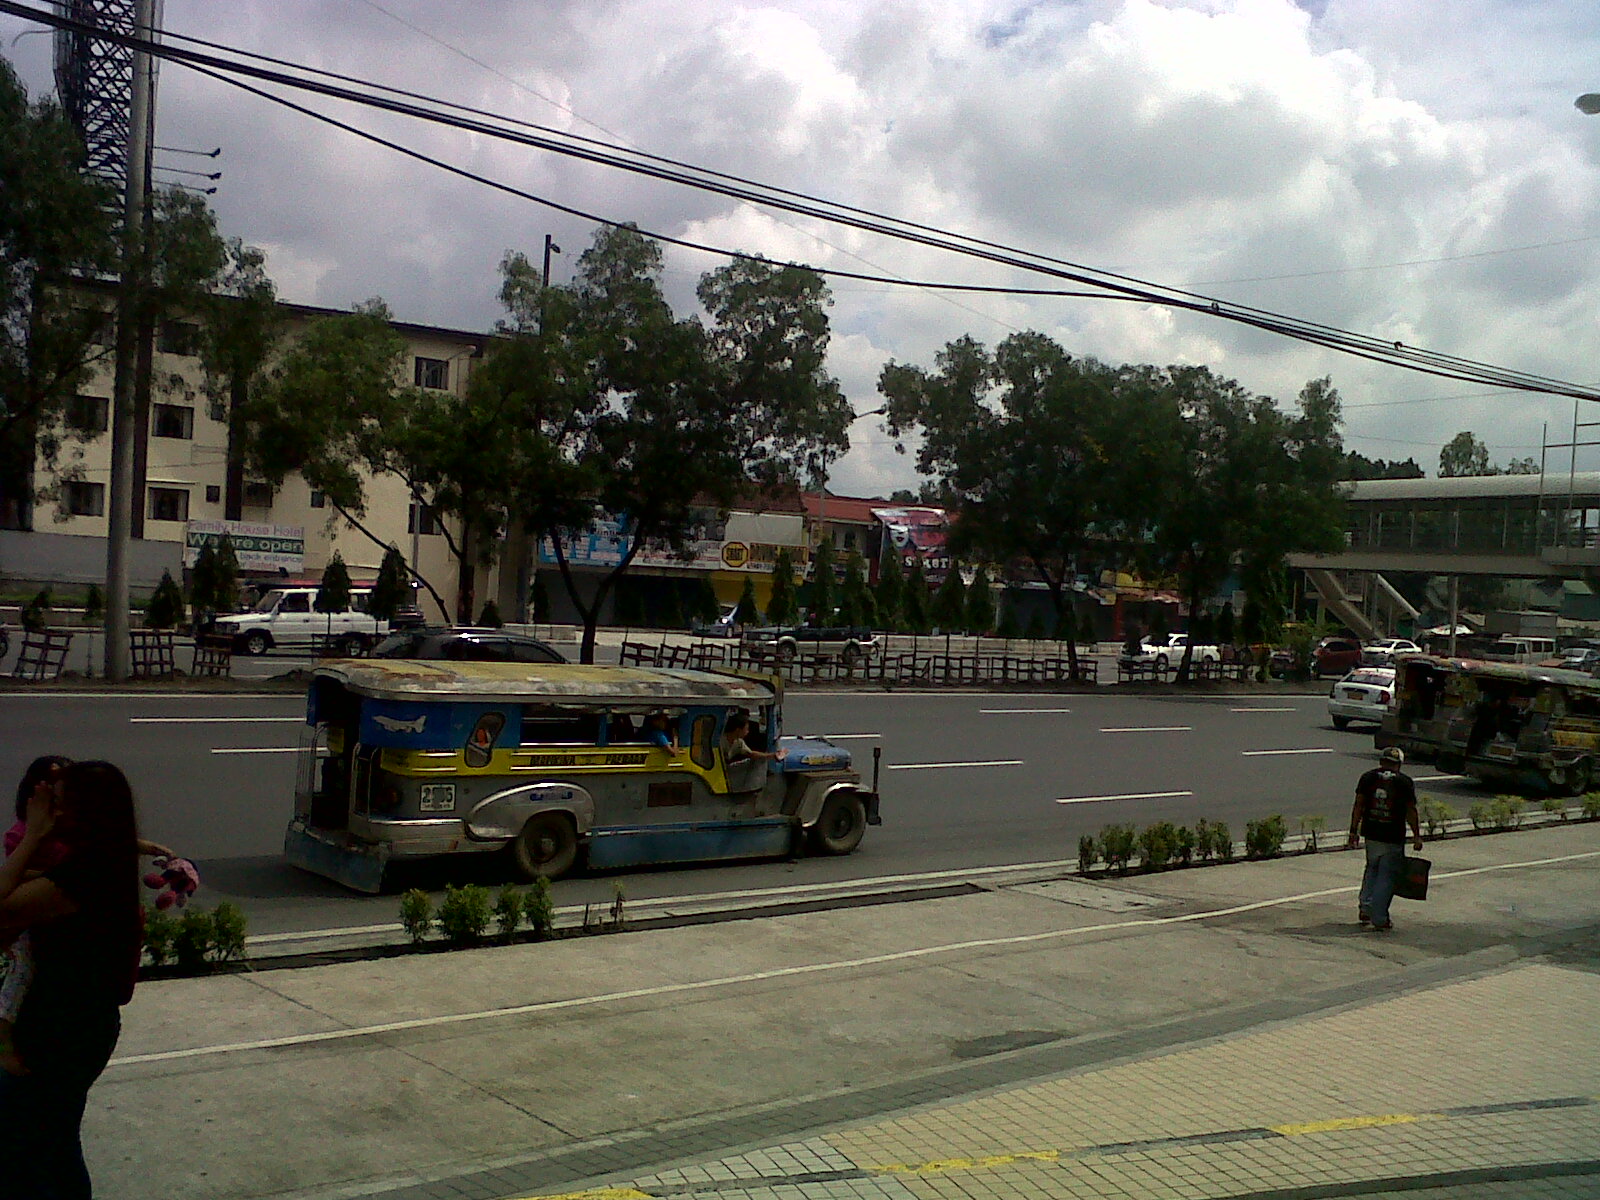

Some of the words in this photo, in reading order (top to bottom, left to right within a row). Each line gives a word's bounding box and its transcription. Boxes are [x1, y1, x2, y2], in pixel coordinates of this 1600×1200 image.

[188, 520, 228, 533] Family
[231, 521, 269, 535] House
[273, 524, 304, 537] Hotel
[259, 540, 303, 553] open
